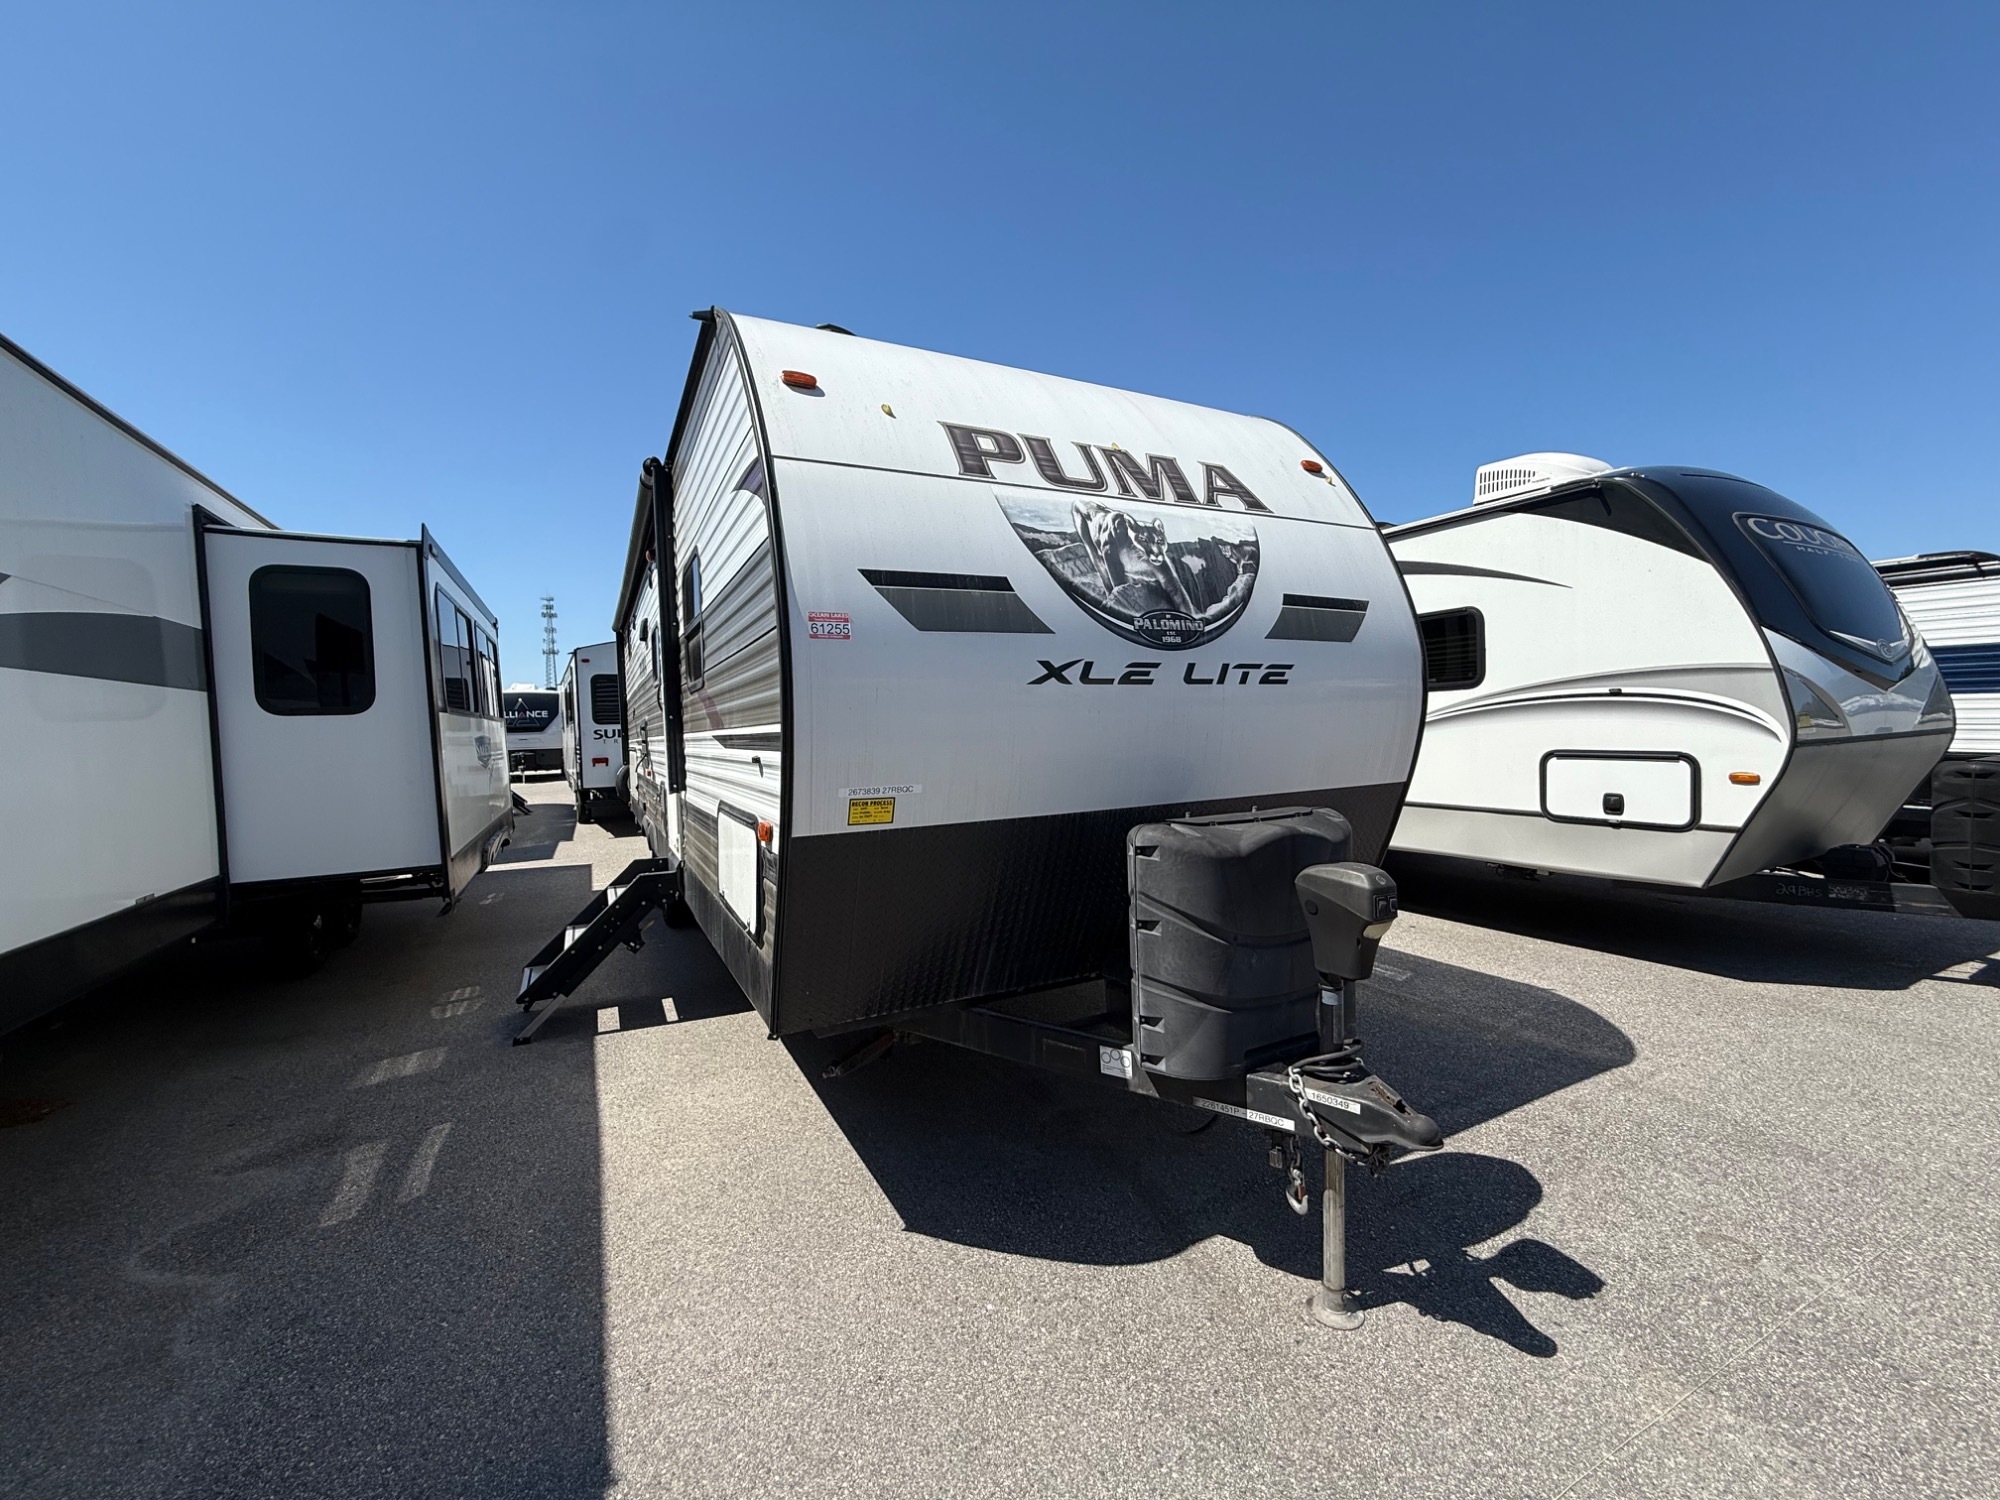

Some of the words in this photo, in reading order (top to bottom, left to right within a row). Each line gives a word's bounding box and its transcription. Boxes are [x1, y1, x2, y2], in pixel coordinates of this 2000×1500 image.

[937, 420, 1275, 513] PUMA
[1747, 518, 1857, 554] COUG
[811, 623, 850, 635] 61255
[1133, 617, 1203, 631] PALOMINO
[1027, 658, 1162, 685] XLE
[1184, 662, 1295, 685] LITE
[504, 710, 549, 718] LLIANCE
[593, 729, 622, 740] SU
[848, 787, 880, 796] 2673839
[882, 785, 914, 795] 27RBQC
[1312, 1092, 1350, 1110] 1650349
[1202, 1099, 1240, 1116] 2261451P
[1249, 1112, 1285, 1127] 27RBQC
